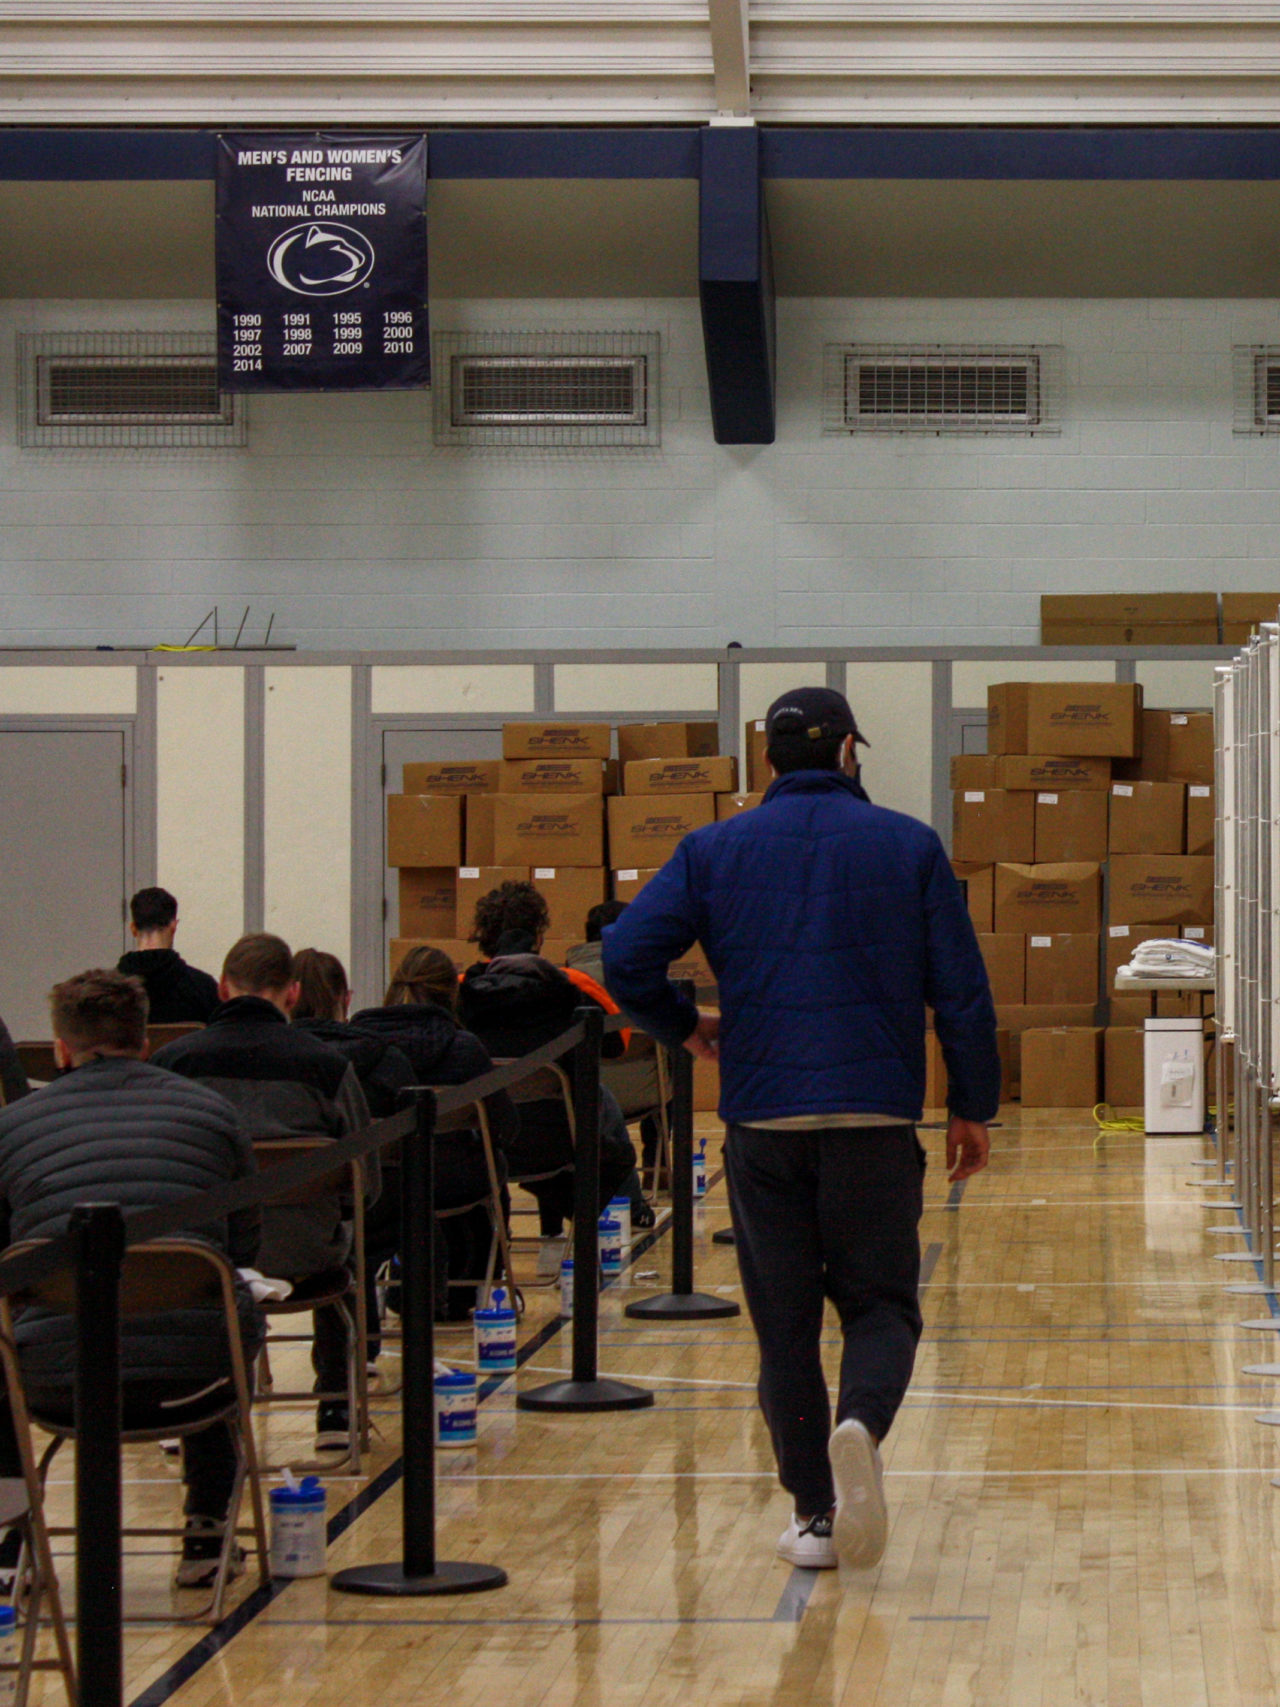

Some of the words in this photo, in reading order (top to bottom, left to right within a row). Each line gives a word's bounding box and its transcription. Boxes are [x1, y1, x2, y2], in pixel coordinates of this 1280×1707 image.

[238, 151, 287, 166] MEN'S
[291, 150, 323, 164] AND
[327, 149, 401, 164] WOMEN'S
[286, 167, 352, 182] FENCING
[302, 190, 335, 202] NCAA
[252, 205, 310, 218] NATIONAL
[314, 203, 386, 216] CHAMPIONS
[232, 315, 261, 327] 1990
[283, 314, 310, 325] 1991
[333, 313, 362, 324] 1995
[383, 312, 413, 323] 1996
[233, 329, 261, 341] 1997
[283, 328, 312, 340] 1998
[333, 328, 362, 339] 1999
[383, 327, 413, 338] 2000
[233, 344, 262, 356] 2002
[283, 344, 312, 355] 2007
[333, 342, 362, 354] 2009
[384, 341, 413, 353] 2010
[233, 359, 262, 371] 2014
